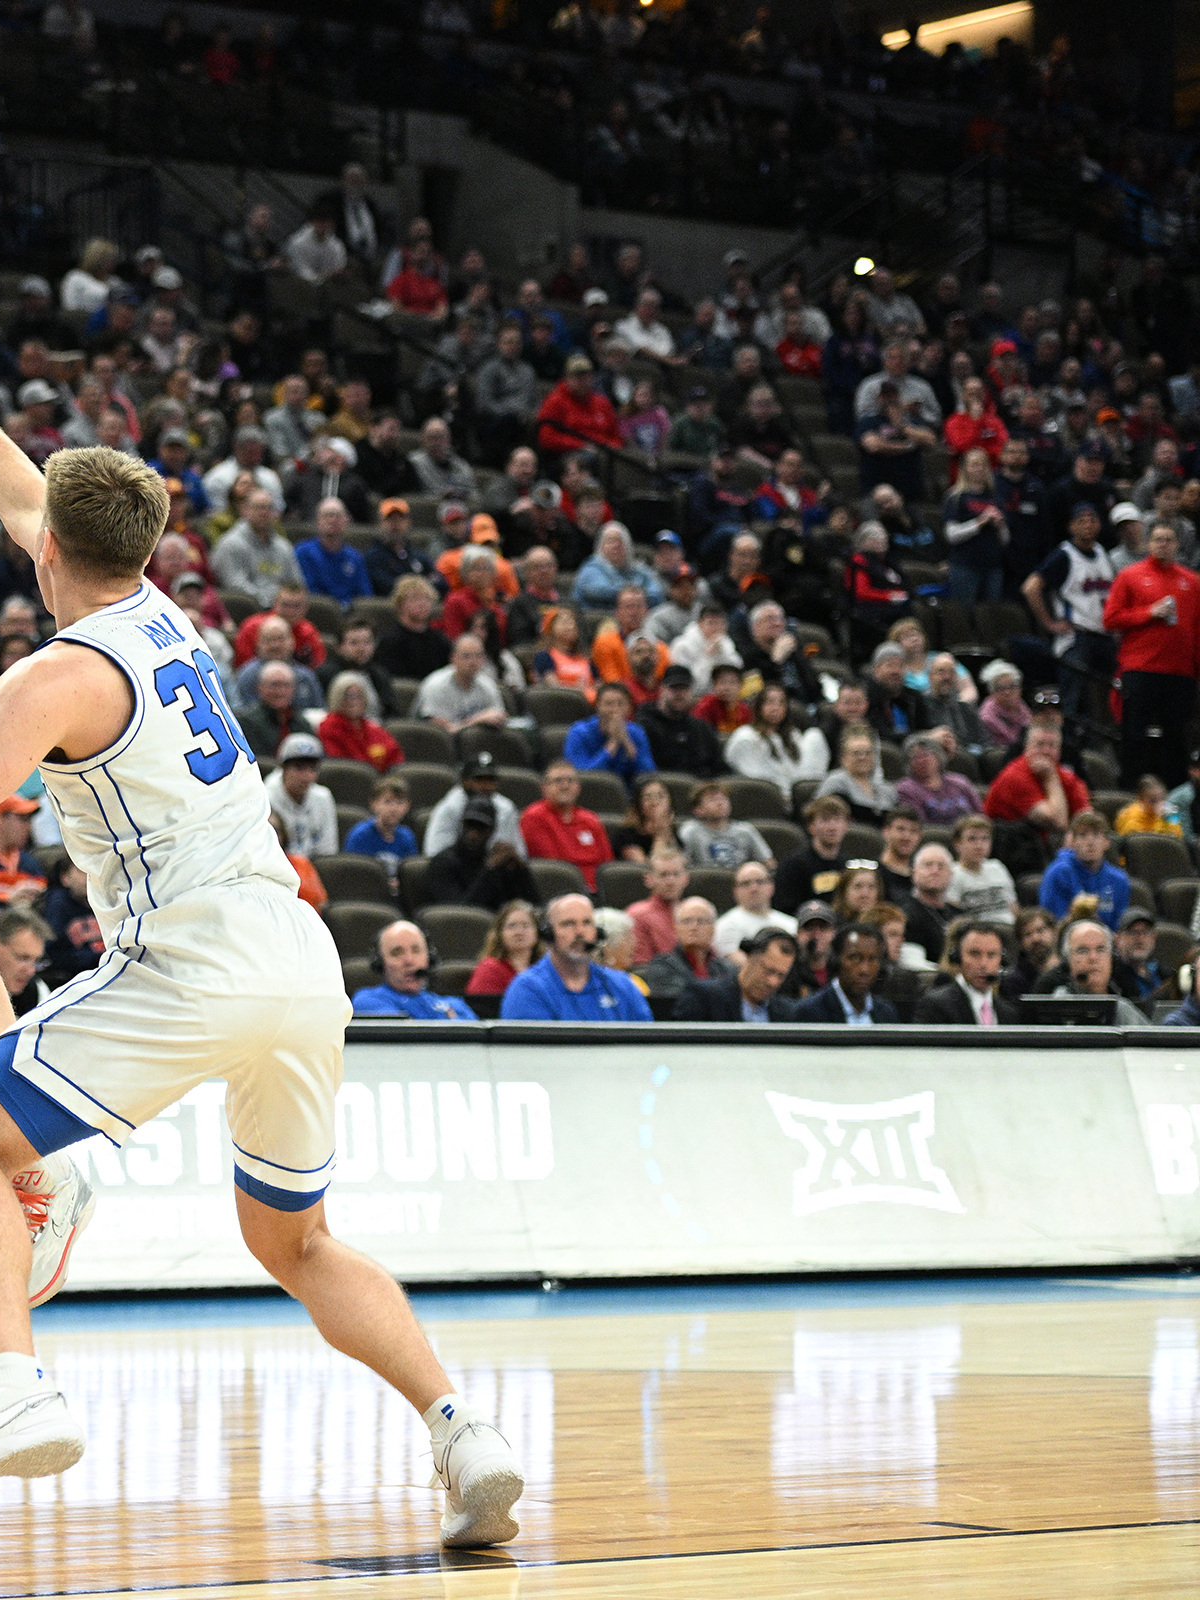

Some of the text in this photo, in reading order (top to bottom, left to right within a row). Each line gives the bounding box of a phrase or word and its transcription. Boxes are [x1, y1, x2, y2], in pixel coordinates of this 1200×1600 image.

[153, 648, 256, 786] 30
[333, 1080, 555, 1183] OUND
[1145, 1103, 1200, 1195] B
